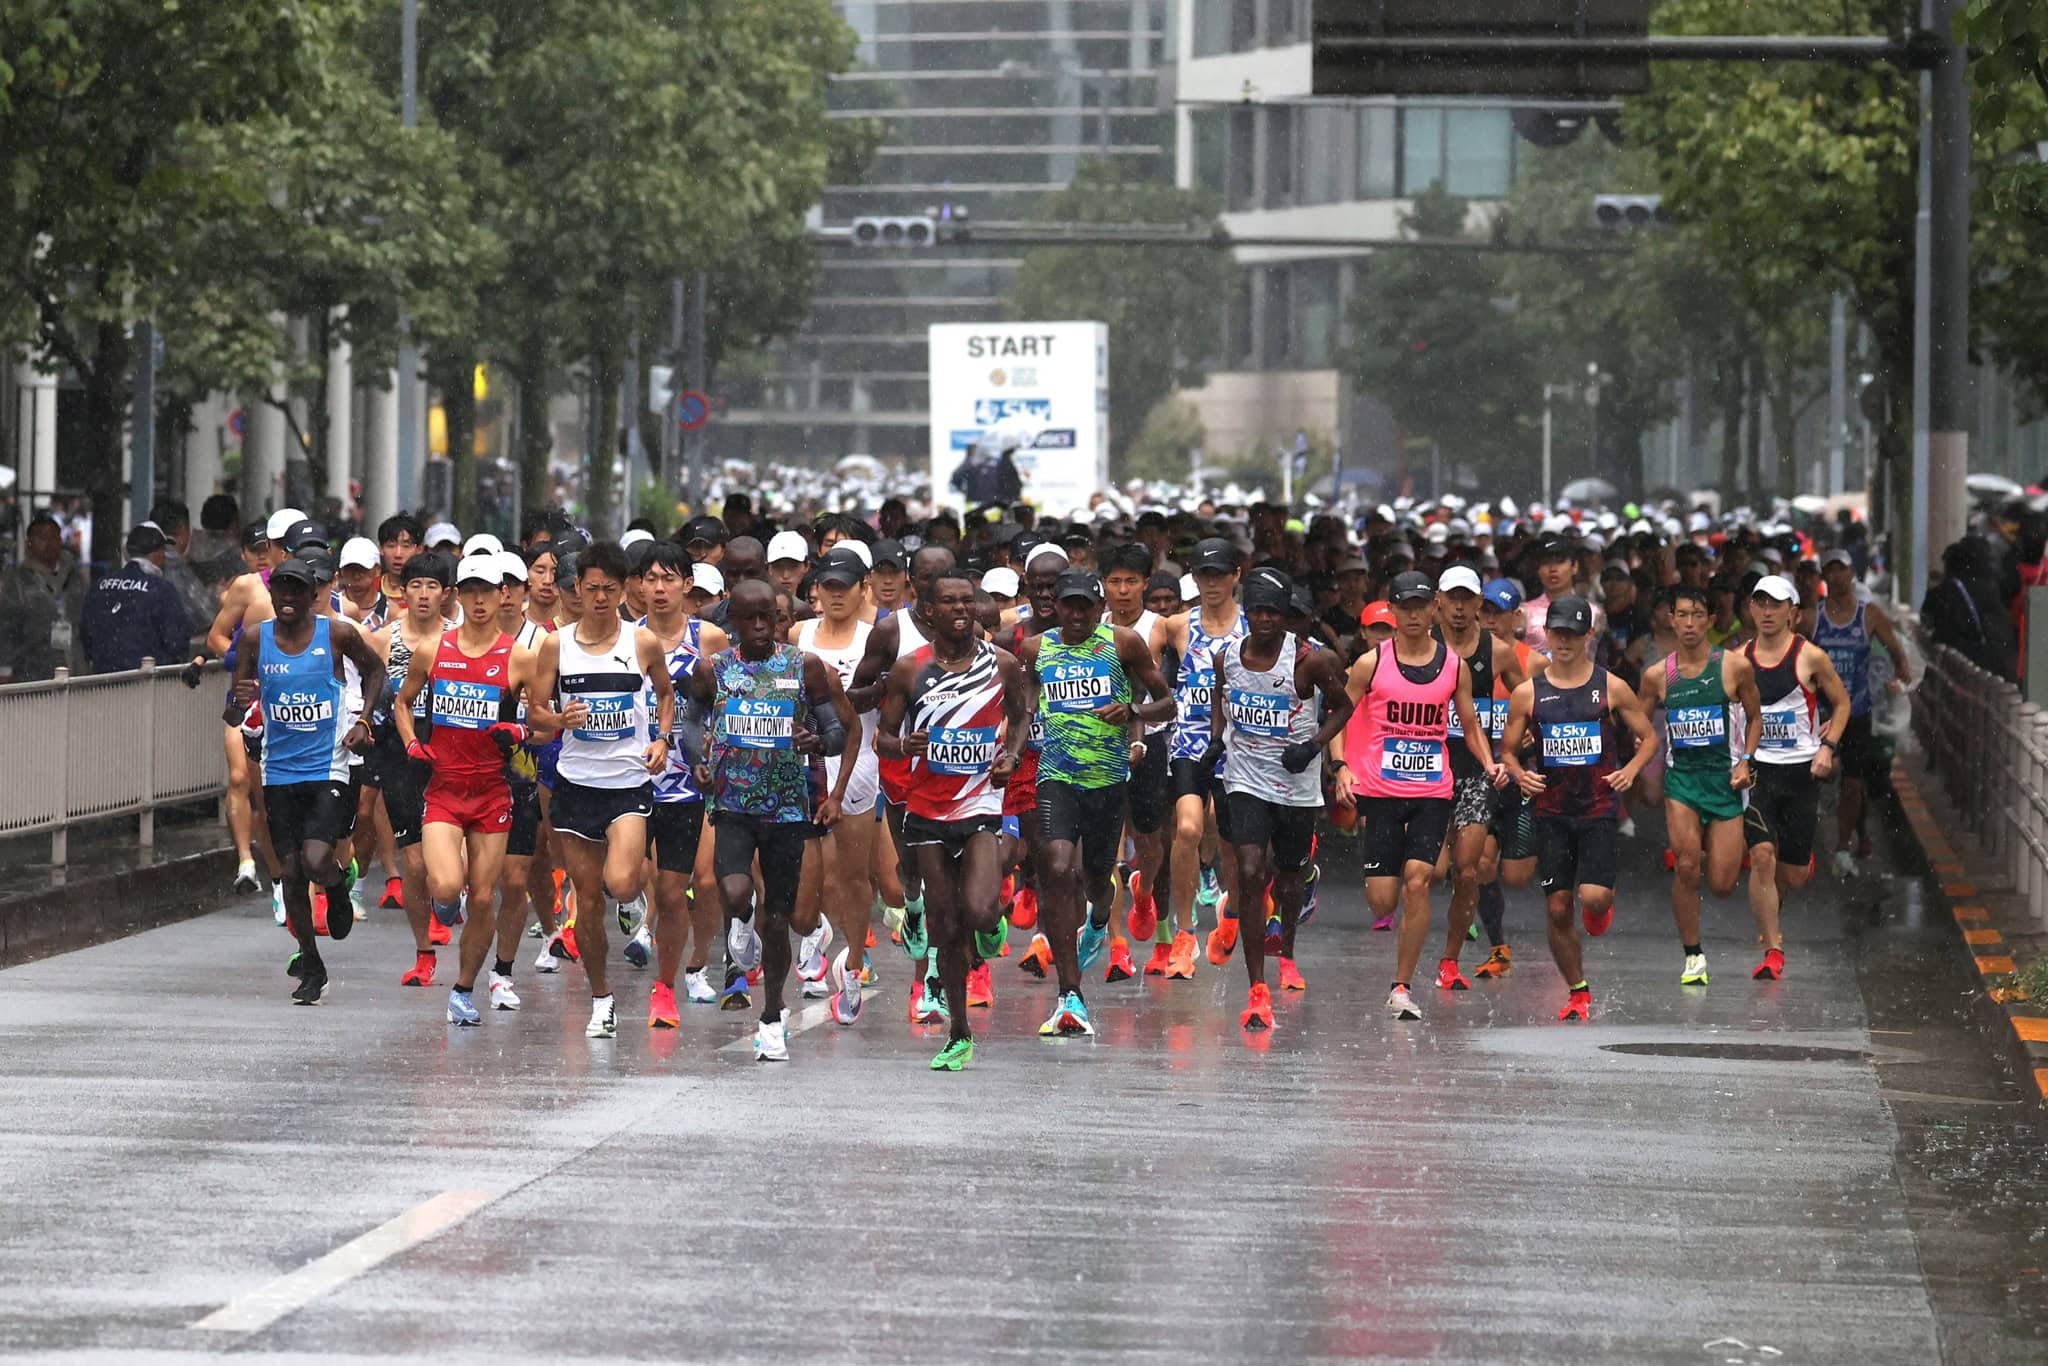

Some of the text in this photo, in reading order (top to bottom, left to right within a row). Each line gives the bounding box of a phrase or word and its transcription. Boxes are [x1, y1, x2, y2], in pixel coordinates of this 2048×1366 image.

[968, 335, 1056, 358] START
[99, 578, 148, 592] OFFICIAL
[263, 664, 290, 674] YKK
[1068, 665, 1094, 678] Sky
[460, 685, 487, 699] Sky
[1047, 678, 1101, 700] MUTISO
[292, 692, 317, 704] Sky
[925, 693, 957, 702] TOYOTA
[1251, 695, 1276, 708] Sky
[435, 696, 488, 718] SADAKATA
[595, 699, 621, 711] Sky
[753, 702, 780, 716] Sky
[273, 703, 322, 722] LOROT
[1231, 705, 1280, 726] LANGAT
[1386, 701, 1444, 726] GUIDE
[1687, 709, 1711, 720] Sky
[1762, 713, 1784, 724] Sky
[578, 712, 627, 730] URAYAMA
[728, 716, 785, 737] MUIVA KITONYI
[1563, 726, 1587, 737] Sky
[1672, 720, 1716, 738] KUMAGAI
[1760, 724, 1790, 739] ANAKA
[956, 731, 983, 744] Sky
[931, 743, 987, 763] KAROKI
[1409, 742, 1431, 754] Sky
[1545, 738, 1594, 755] KARASAWA
[1392, 754, 1434, 770] GUIDE
